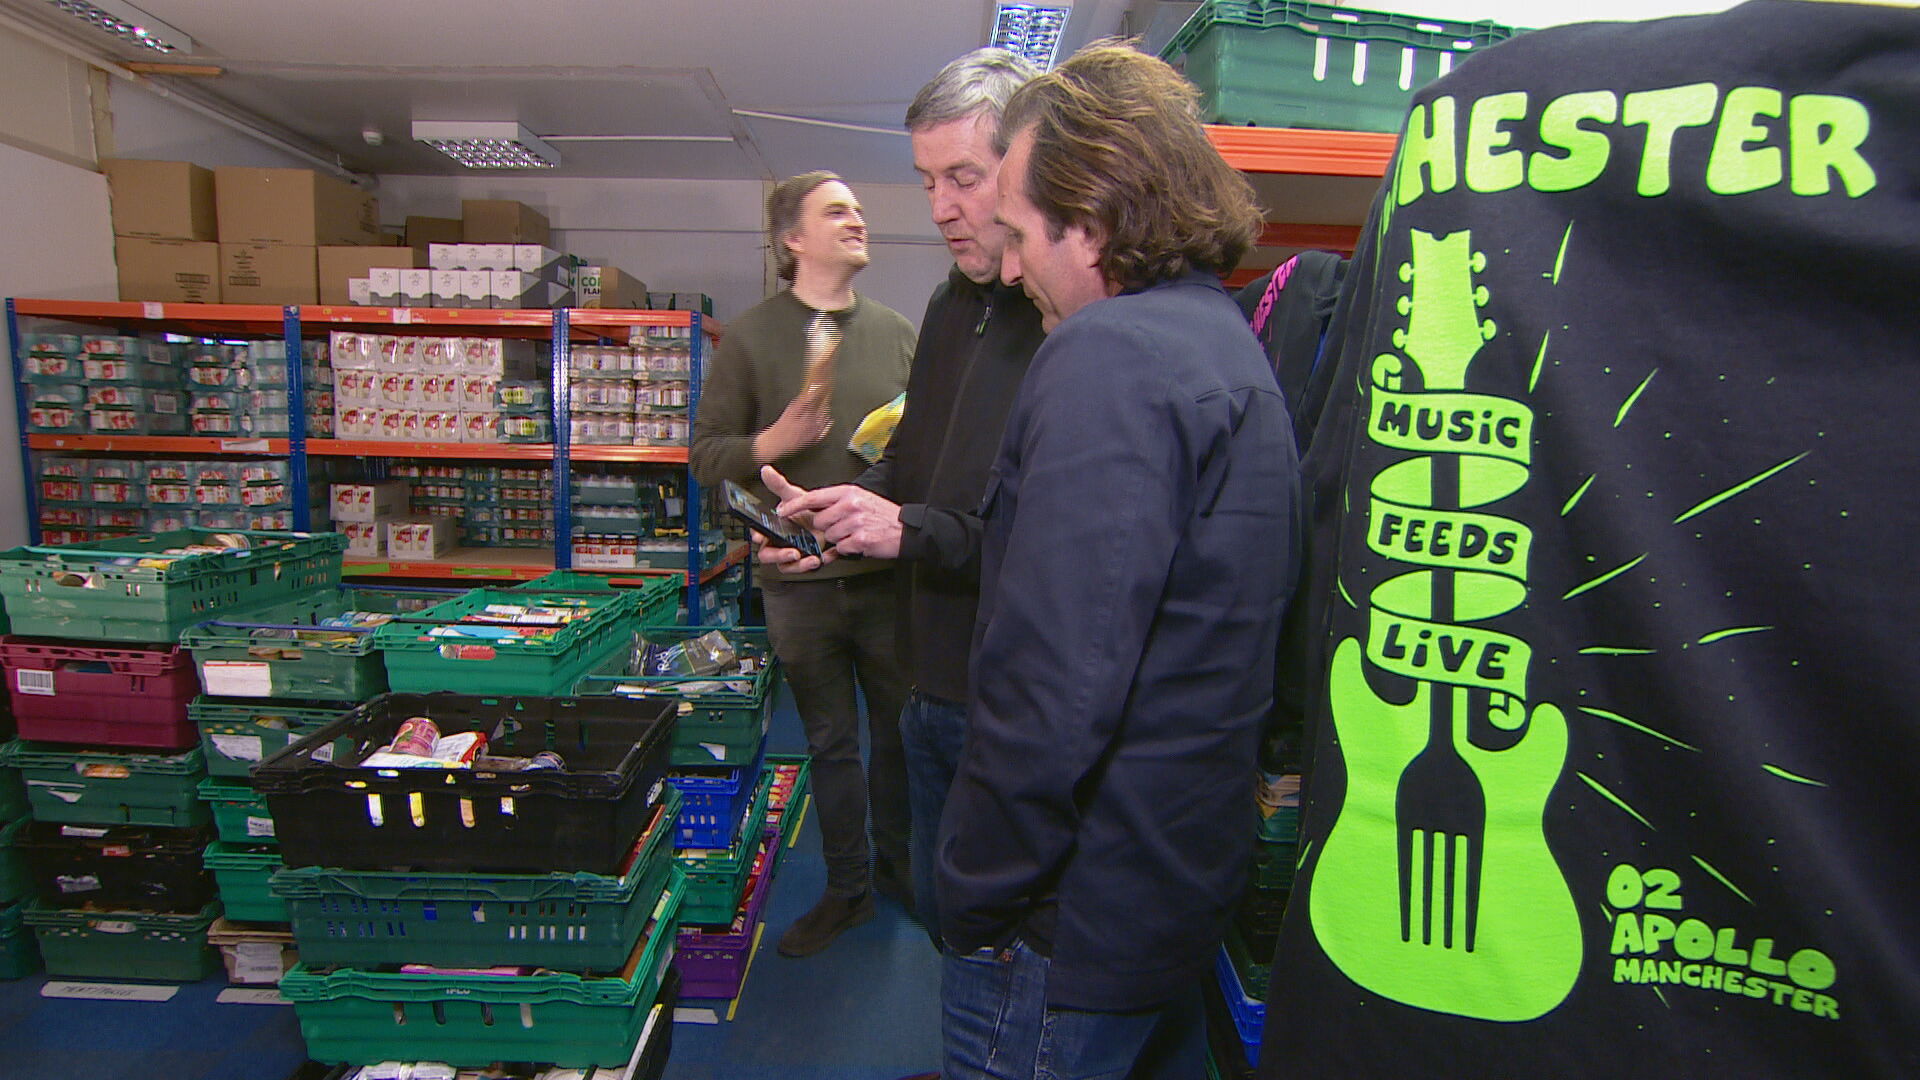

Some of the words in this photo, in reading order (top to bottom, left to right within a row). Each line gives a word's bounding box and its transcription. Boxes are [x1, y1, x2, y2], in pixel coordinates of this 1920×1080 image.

[1391, 82, 1878, 206] HESTER
[581, 276, 601, 287] CO
[1378, 513, 1518, 564] FEEDS
[1610, 912, 1837, 990] APOLLO
[1613, 958, 1841, 1020] MANCHESTER
